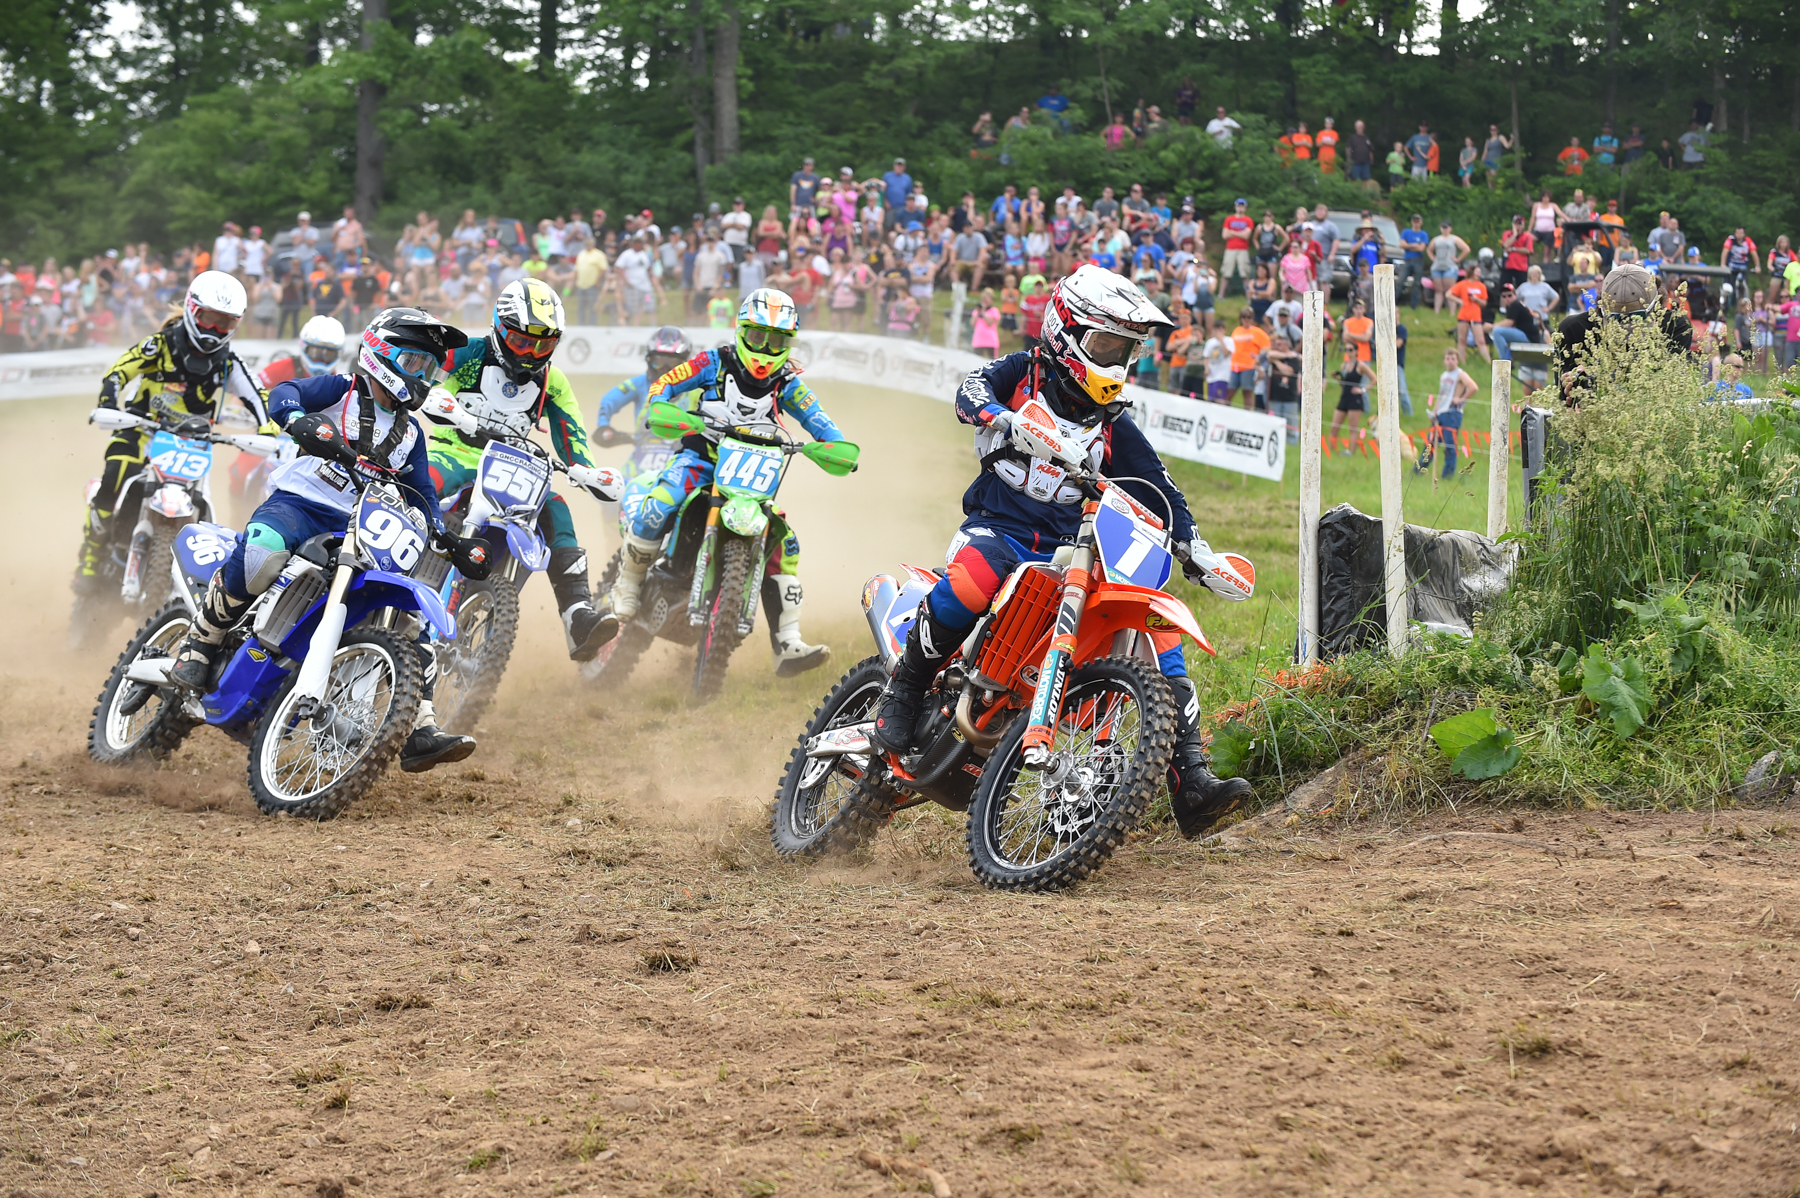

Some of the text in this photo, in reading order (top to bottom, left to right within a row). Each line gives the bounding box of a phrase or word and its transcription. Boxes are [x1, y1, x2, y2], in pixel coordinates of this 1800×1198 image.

[362, 328, 395, 356] 100%
[381, 372, 396, 388] 996
[1020, 422, 1062, 453] ACERBIS
[151, 450, 210, 478] 413
[717, 451, 782, 493] 445
[1036, 463, 1062, 478] KTM
[369, 490, 426, 531] JONES
[186, 534, 226, 566] 96
[359, 509, 425, 571] 96
[1113, 529, 1154, 578] 1
[1210, 567, 1251, 594] ACERBIS
[1031, 668, 1053, 722] MOTOREX
[1047, 655, 1067, 724] DUNLOP
